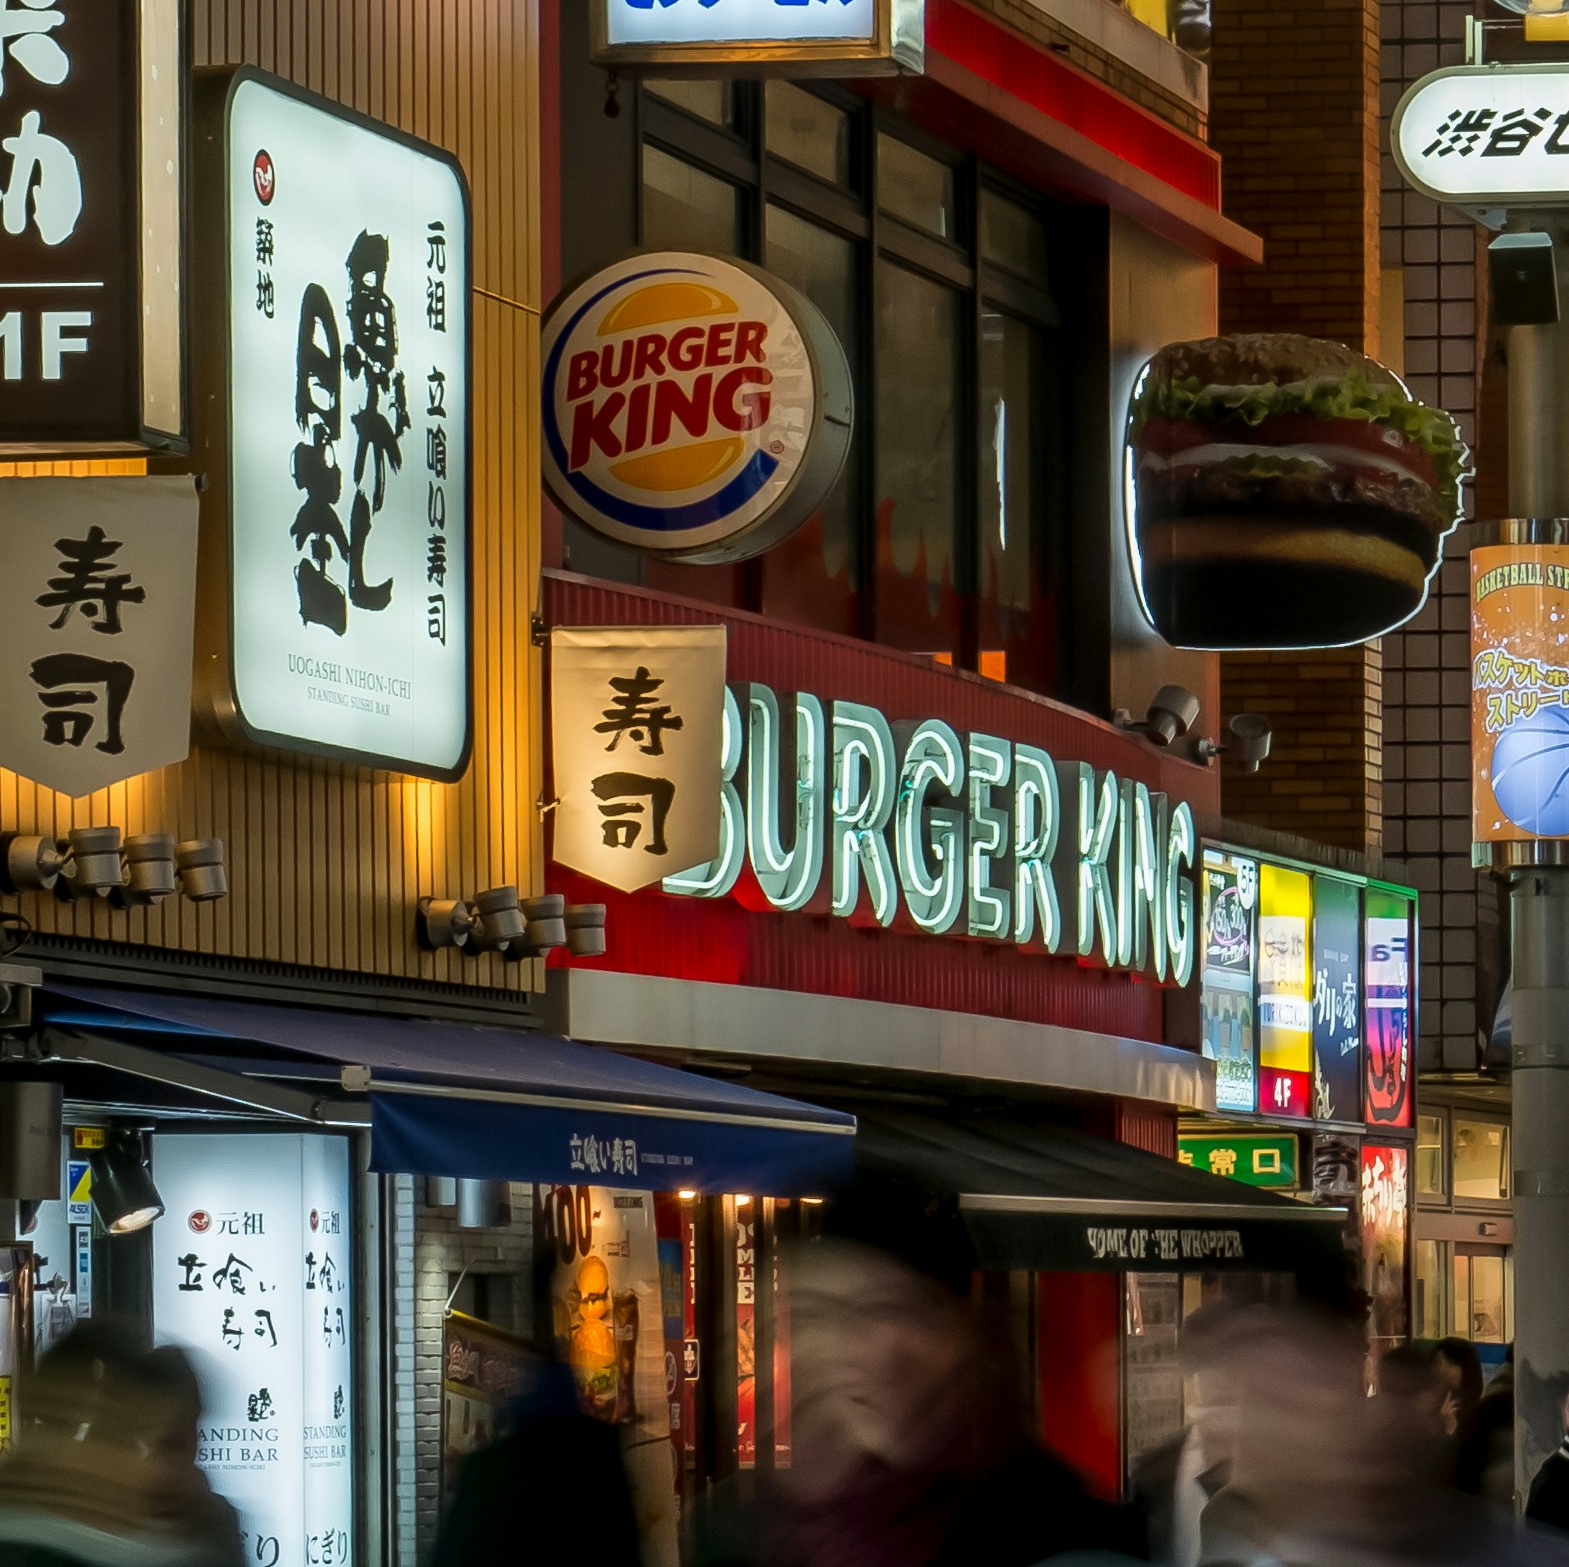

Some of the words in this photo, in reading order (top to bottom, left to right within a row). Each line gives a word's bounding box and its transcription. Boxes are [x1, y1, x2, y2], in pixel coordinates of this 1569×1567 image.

[254, 216, 276, 320] 築地
[426, 221, 448, 335] 元祖
[567, 320, 768, 404] BURGER
[567, 366, 772, 474] KING
[426, 365, 448, 648] 立喰い寿司
[1475, 563, 1544, 606] BASKETBALL
[29, 525, 147, 756] 寿司
[288, 652, 342, 688] UOGASHI
[345, 666, 412, 702] NIHON-ICHI
[591, 666, 684, 855] 寿司
[1079, 761, 1197, 988] KING
[1273, 1076, 1292, 1108] 4F
[568, 1132, 638, 1176] 立喰い寿司
[215, 1210, 265, 1236] 元祖
[319, 1209, 342, 1235] 元祖
[177, 1252, 277, 1296] 立喰い
[222, 1305, 278, 1352] 寿司
[198, 1427, 279, 1443] ANDING
[198, 1446, 233, 1462] SHI
[239, 1446, 279, 1462] BAR
[302, 1424, 347, 1441] STANDING
[302, 1443, 330, 1460] SUSHI
[333, 1442, 347, 1459] BAR
[305, 1530, 348, 1567] にぎり
